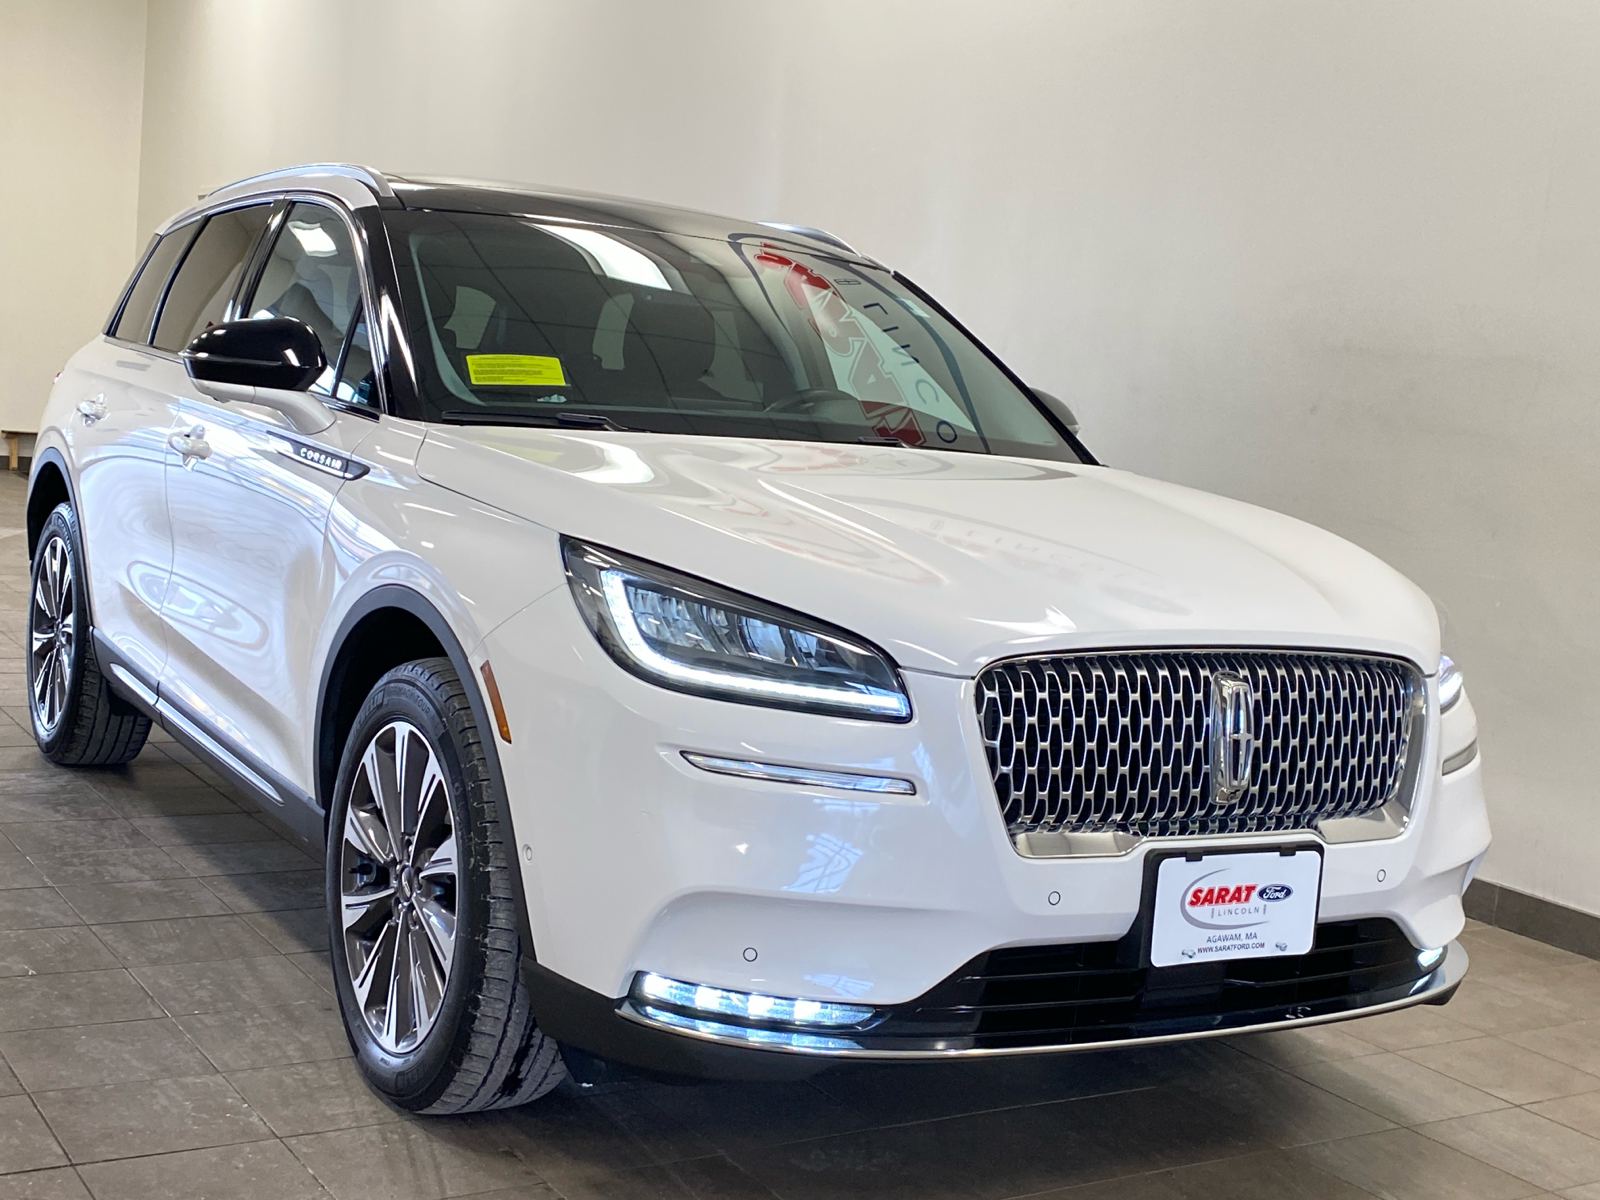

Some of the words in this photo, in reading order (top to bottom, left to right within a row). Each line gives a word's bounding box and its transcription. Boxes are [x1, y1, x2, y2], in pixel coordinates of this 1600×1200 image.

[300, 447, 342, 470] CORSAIR
[1187, 883, 1258, 908] SARAT
[1261, 885, 1288, 900] Ford
[1217, 906, 1260, 917] LINCOLN
[1206, 933, 1243, 944] AGAWAM,
[1245, 932, 1258, 940] MA
[1197, 942, 1265, 954] WWW.SARATFORD.COM
